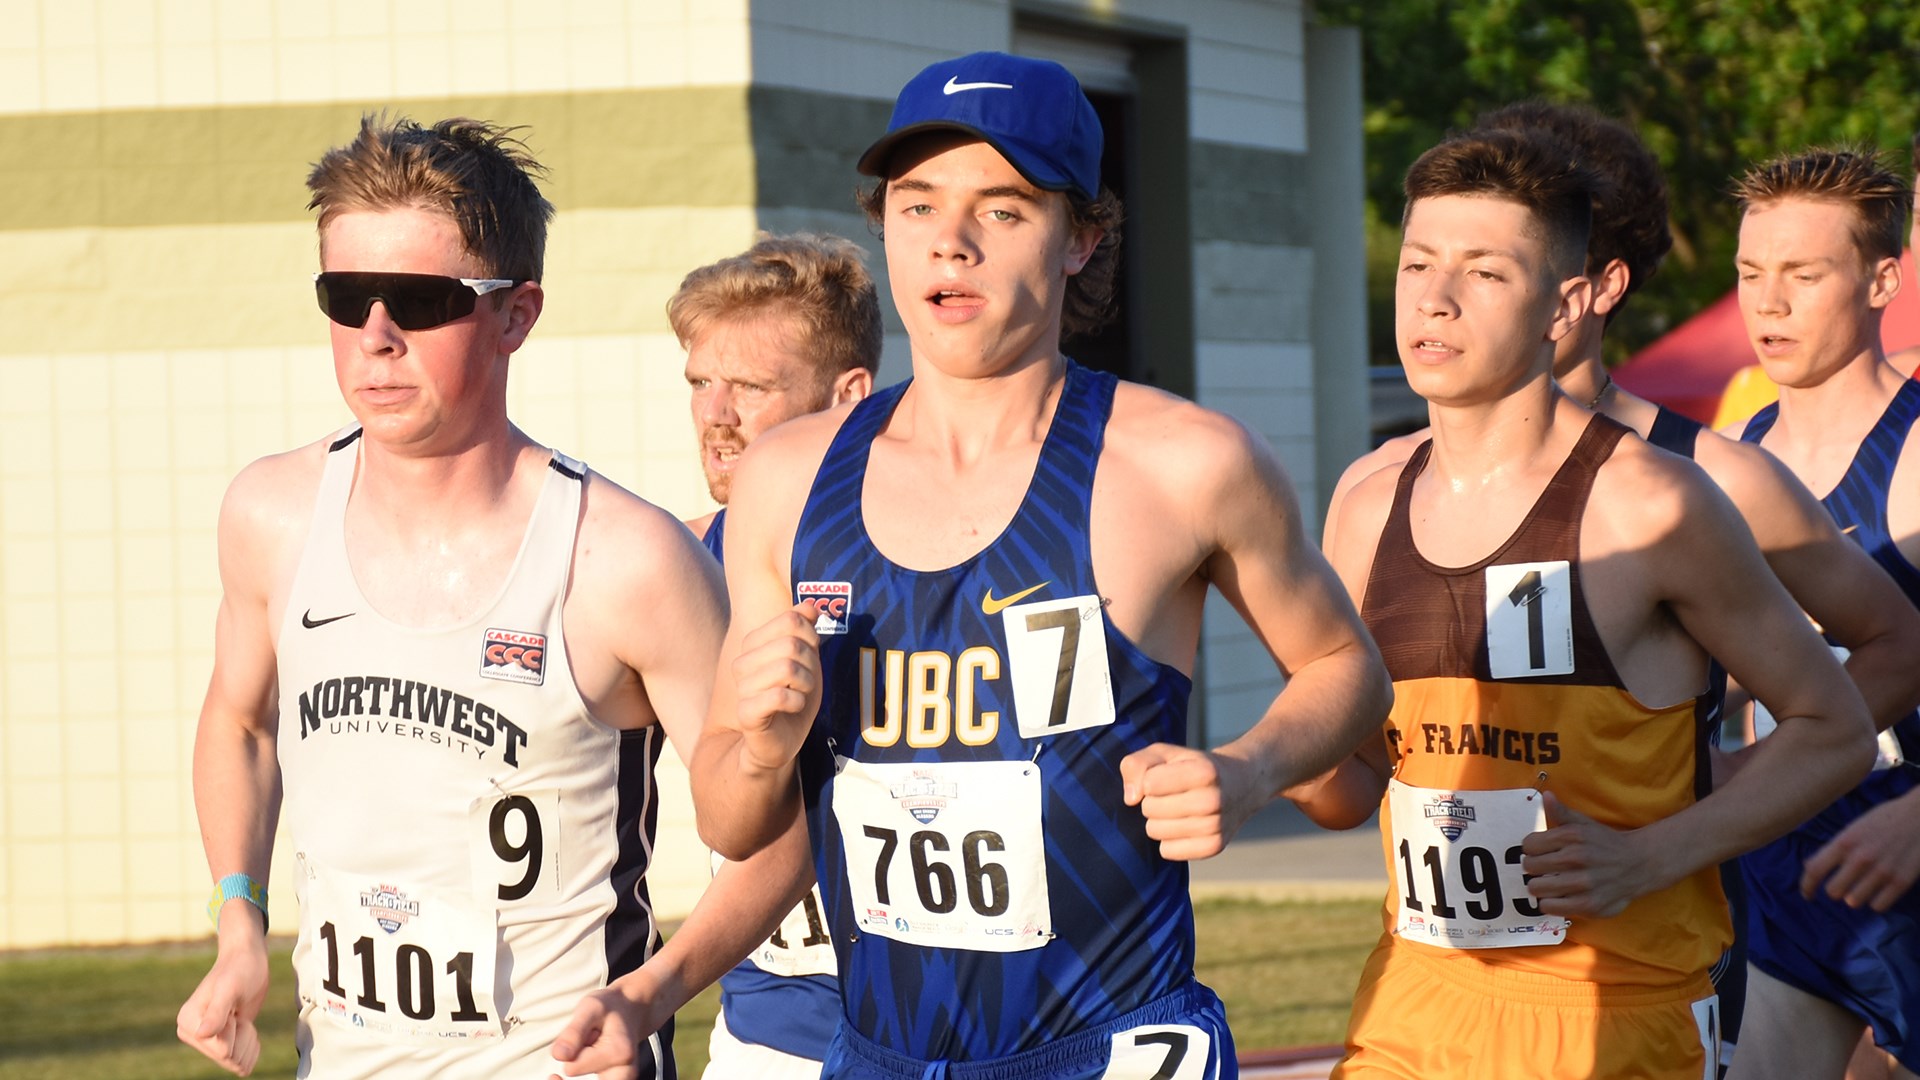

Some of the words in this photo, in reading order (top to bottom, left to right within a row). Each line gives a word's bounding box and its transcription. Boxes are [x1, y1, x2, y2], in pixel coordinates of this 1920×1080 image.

[799, 585, 849, 593] CASCADE
[487, 631, 545, 646] CASCADE
[1508, 570, 1546, 670] 1
[486, 643, 543, 669] CCC
[1025, 607, 1081, 727] 7
[859, 646, 1000, 748] UBC
[299, 676, 528, 769] NORTHWEST
[330, 720, 486, 760] UNIVERSITY
[1421, 723, 1561, 765] FRANCIS
[1425, 805, 1449, 817] TRACK
[1453, 806, 1475, 820] FIELD
[489, 795, 543, 901] 9
[862, 824, 1010, 917] 766
[1507, 926, 1535, 934] UCS
[320, 921, 489, 1022] 1101
[438, 1031, 467, 1039] UCS
